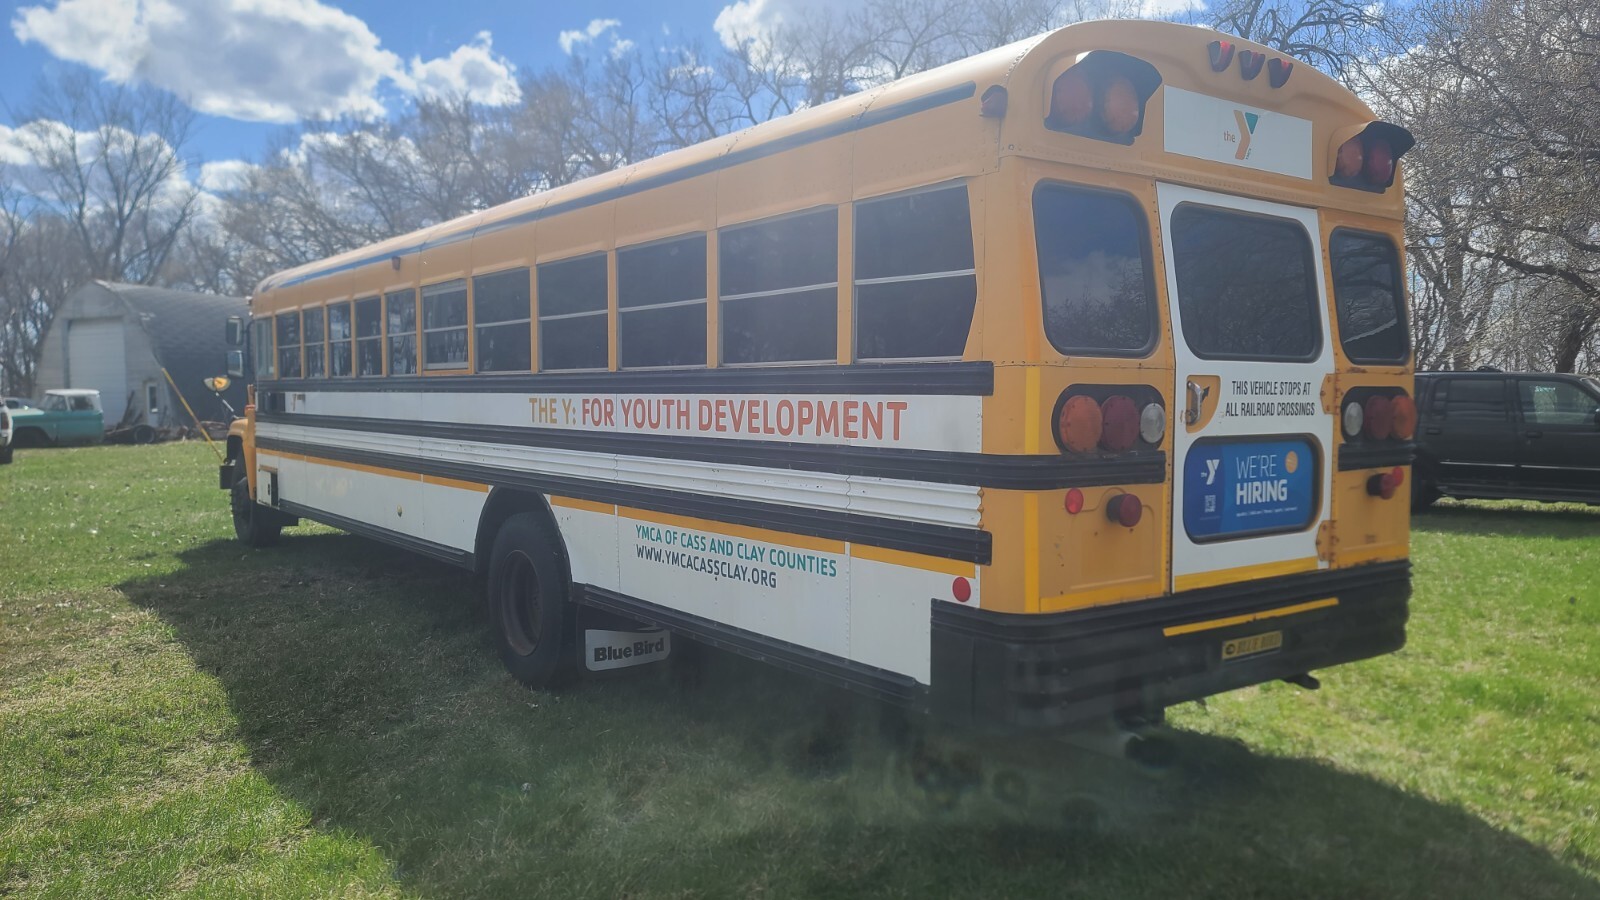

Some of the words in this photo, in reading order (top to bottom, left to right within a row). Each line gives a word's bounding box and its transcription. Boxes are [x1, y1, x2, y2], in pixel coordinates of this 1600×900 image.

[1224, 131, 1235, 142] the
[1232, 380, 1248, 395] THIS
[1250, 381, 1278, 395] VEHICLE
[1279, 381, 1301, 396] STOPS
[1302, 382, 1311, 395] AT
[529, 397, 557, 424] THE
[561, 398, 577, 425] Y:
[582, 398, 615, 427] FOR
[620, 398, 690, 430] YOUTH
[698, 399, 908, 441] DEVELOPMENT
[1225, 402, 1239, 416] ALL
[1241, 402, 1275, 416] RAILROAD
[1277, 402, 1315, 416] CROSSINGS
[1236, 455, 1277, 479] WE'RE
[1236, 479, 1288, 505] HIRING
[635, 524, 662, 543] YMCA
[665, 529, 678, 545] OF
[680, 532, 706, 551] CASS
[709, 538, 734, 557] AND
[737, 543, 765, 562] CLAY
[769, 548, 837, 577] COUNTIES
[635, 544, 777, 588] WWW.YMCACASSCLAY.ORG
